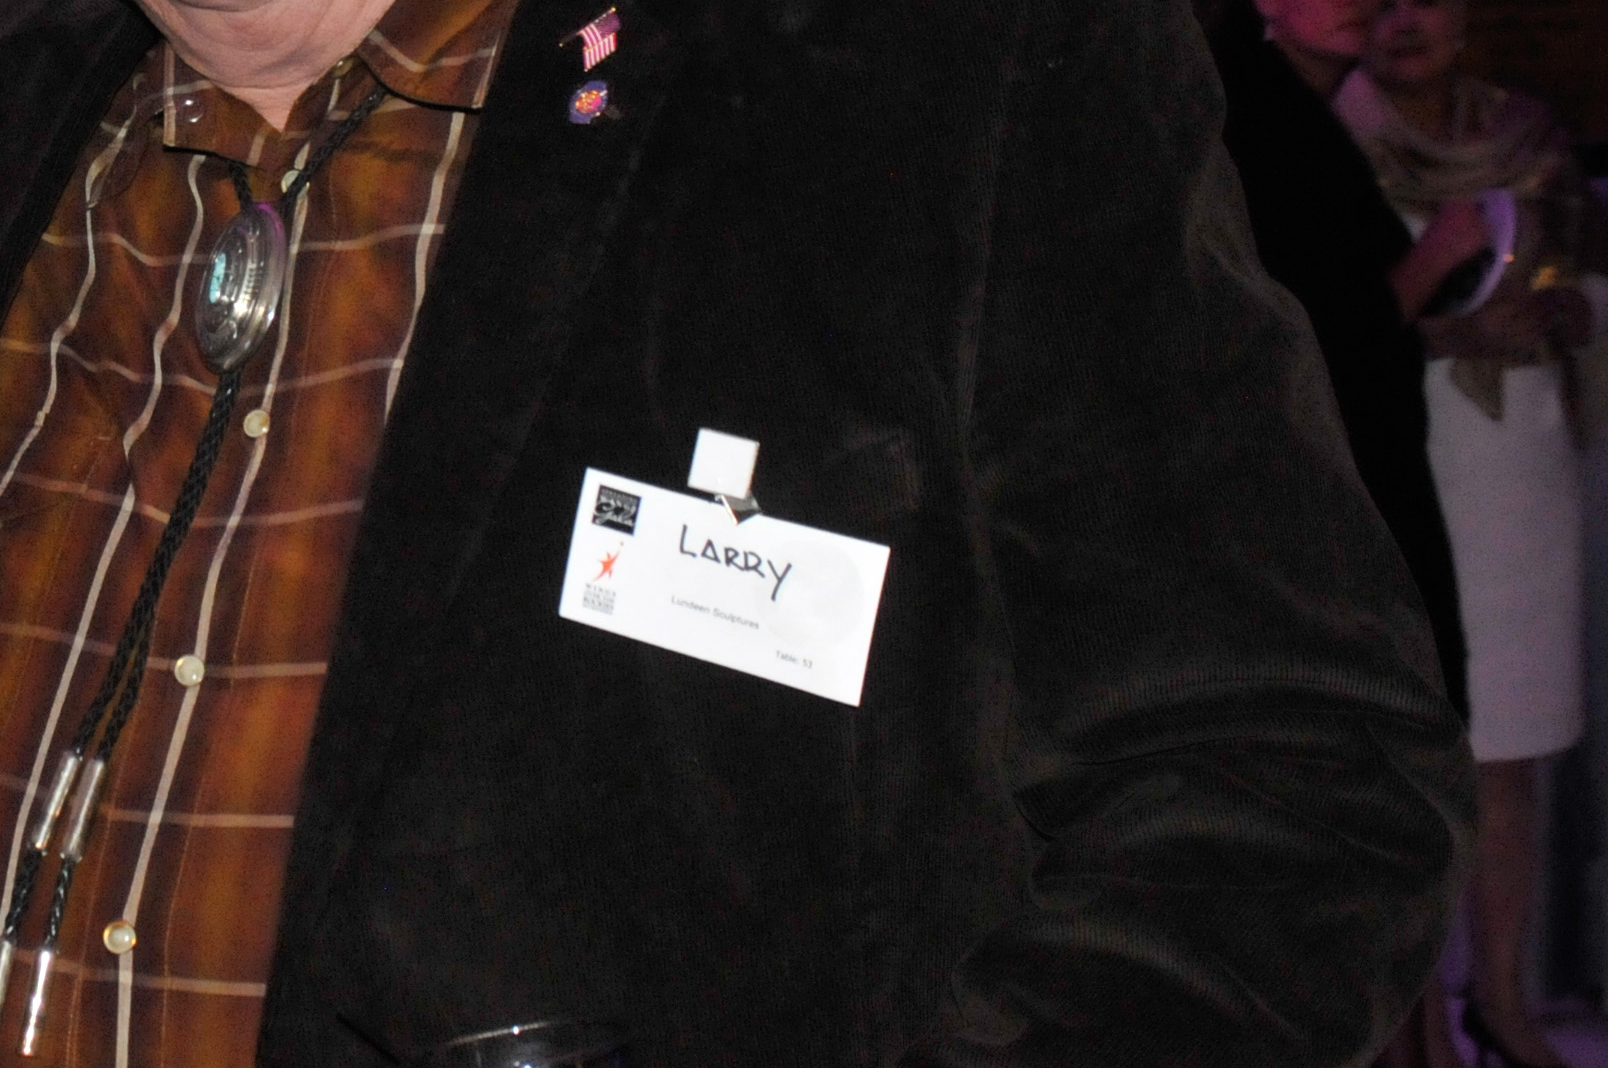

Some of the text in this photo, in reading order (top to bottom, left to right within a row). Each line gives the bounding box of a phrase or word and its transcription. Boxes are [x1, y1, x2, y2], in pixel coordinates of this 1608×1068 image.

[679, 523, 792, 602] LARRY
[671, 595, 760, 630] Lundeen Sculptures
